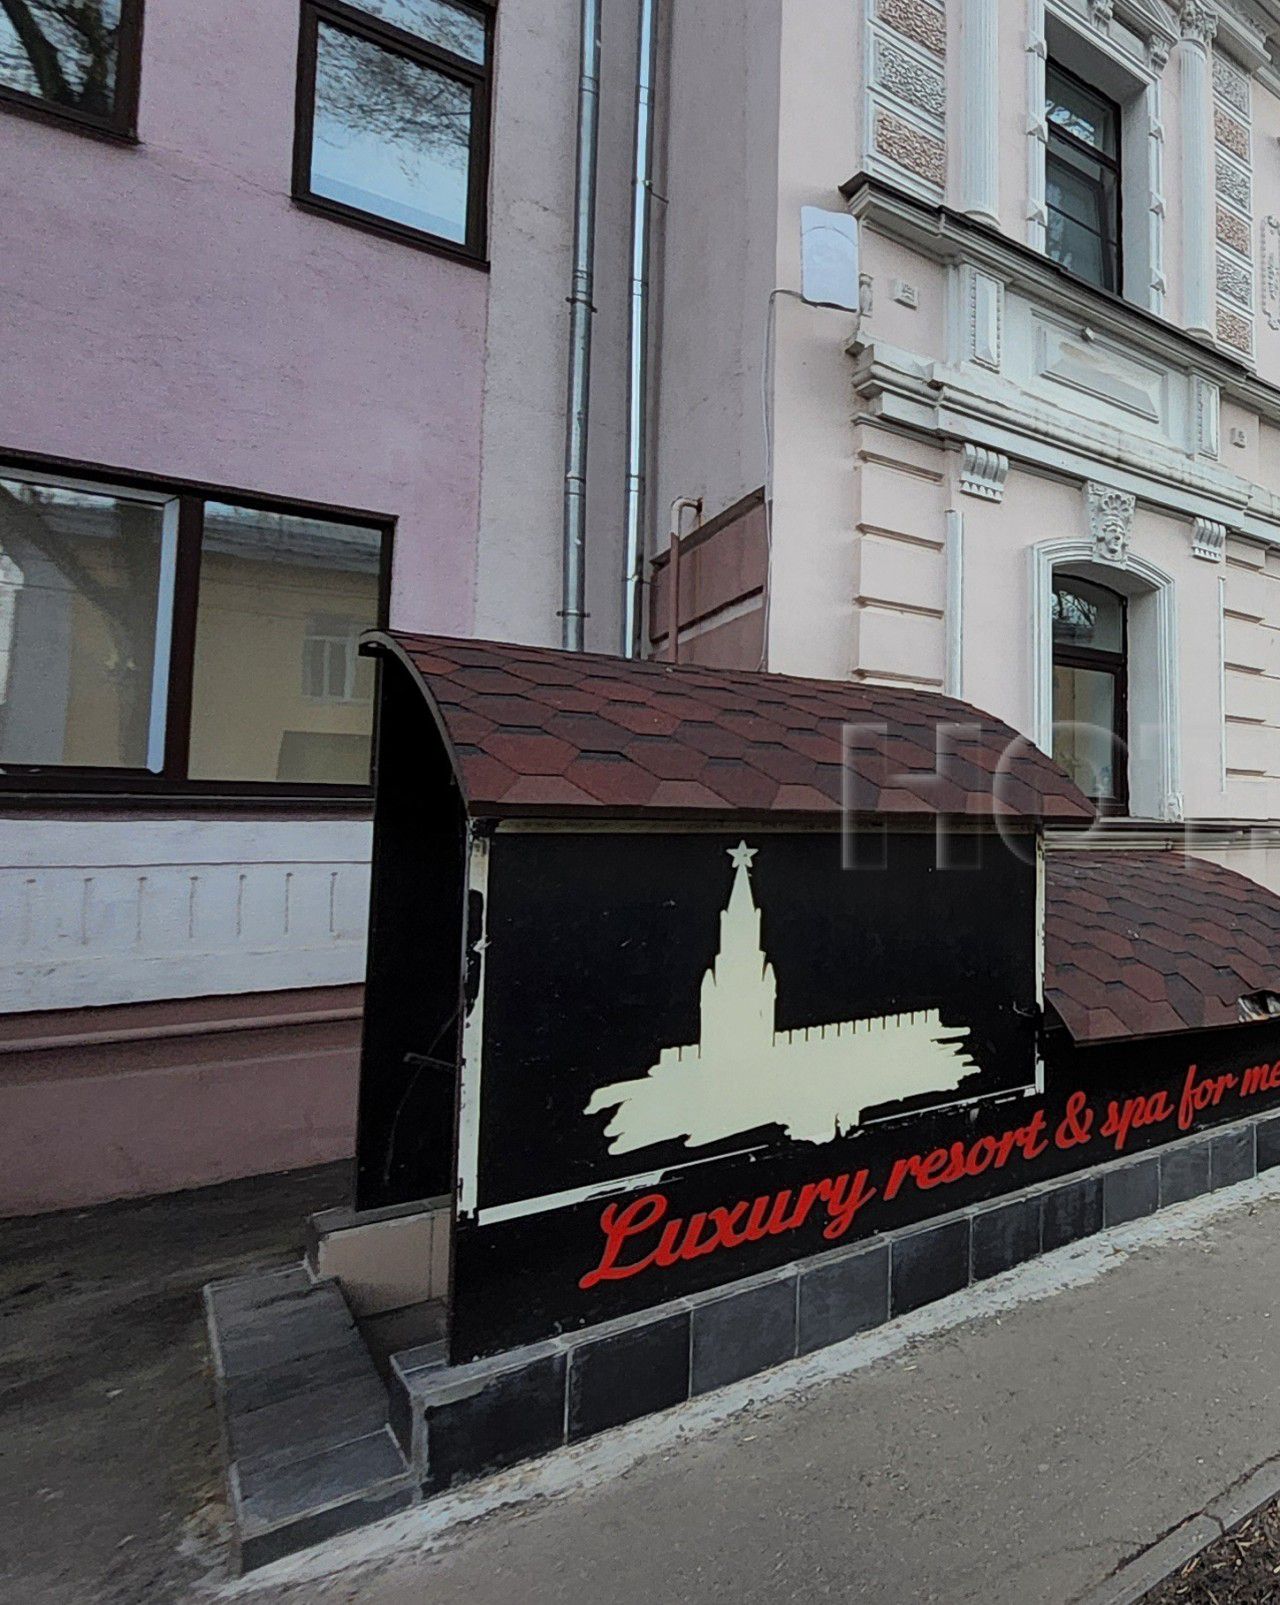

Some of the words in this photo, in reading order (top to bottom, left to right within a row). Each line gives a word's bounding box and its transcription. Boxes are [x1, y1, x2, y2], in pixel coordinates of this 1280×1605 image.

[578, 1168, 876, 1290] Luxury
[882, 1108, 1049, 1201] resort
[1054, 1090, 1094, 1150] &
[1100, 1090, 1175, 1150] spa
[1177, 1064, 1239, 1130] for
